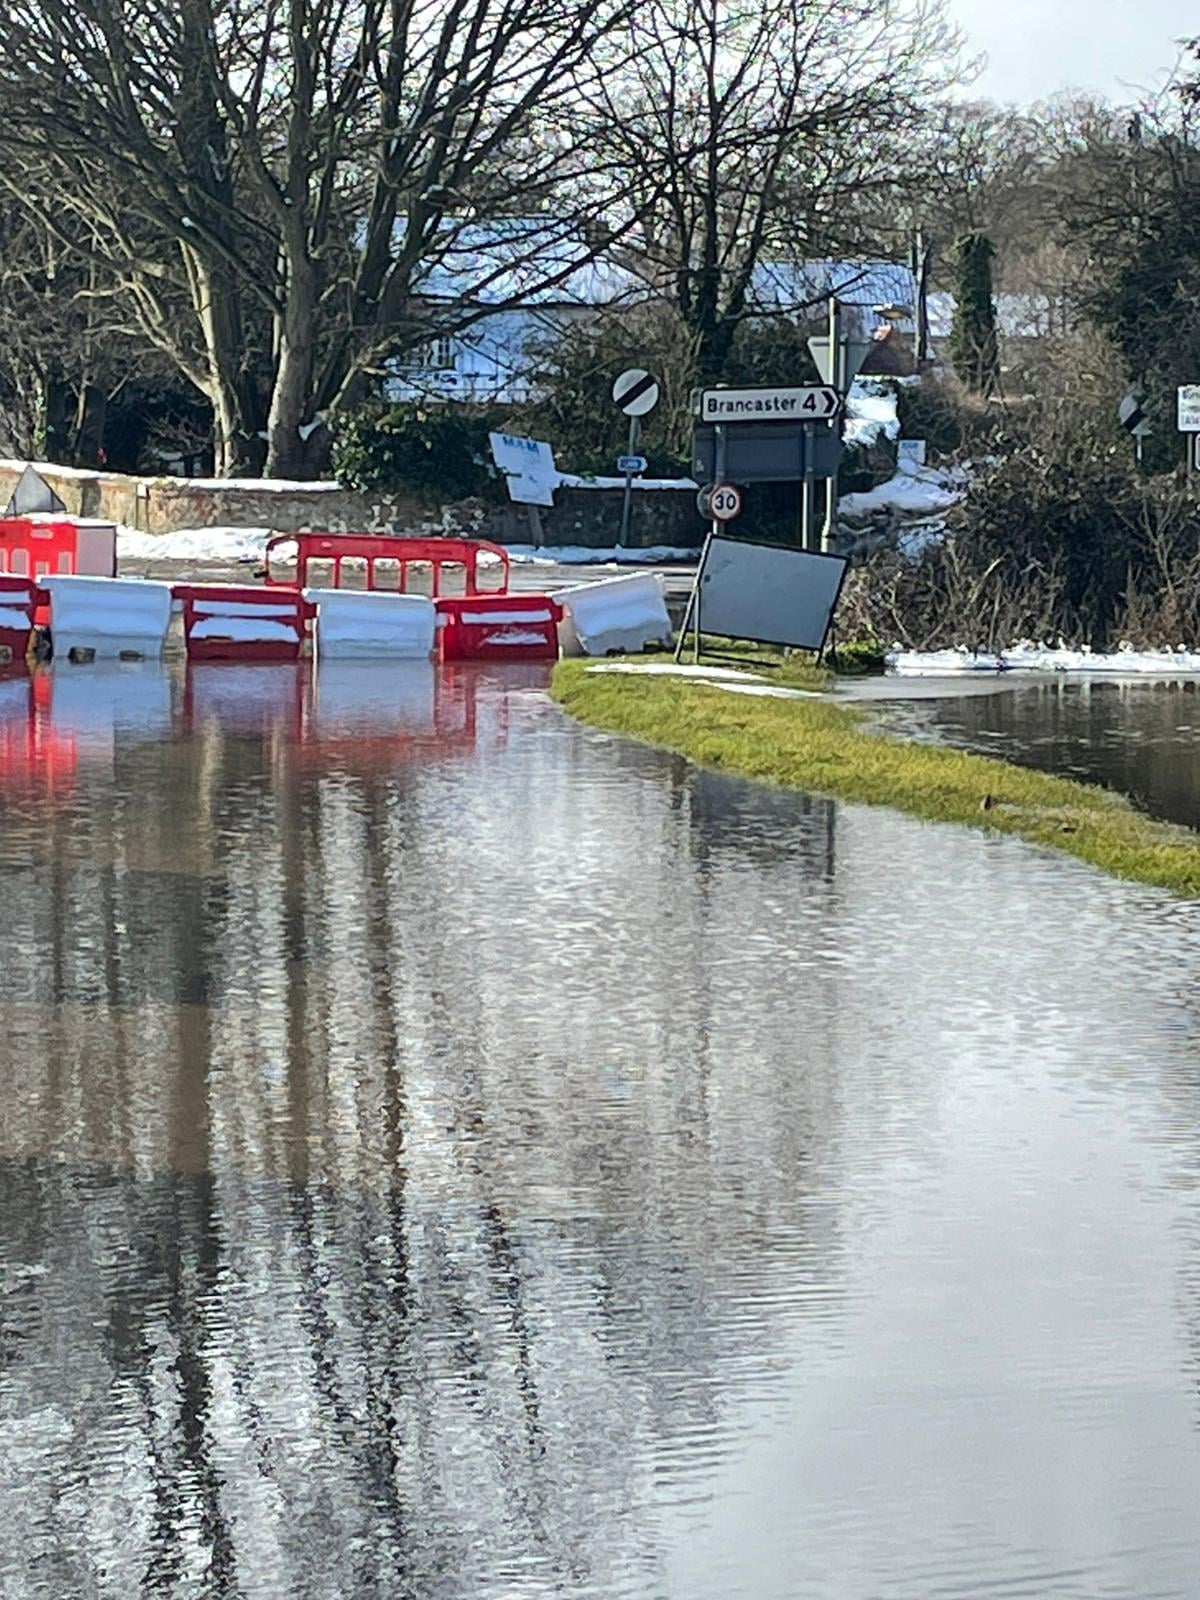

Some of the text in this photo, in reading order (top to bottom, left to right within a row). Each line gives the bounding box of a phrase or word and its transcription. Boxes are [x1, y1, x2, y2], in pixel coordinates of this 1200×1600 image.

[707, 392, 817, 413] Brancaster 4
[714, 493, 737, 510] 30
